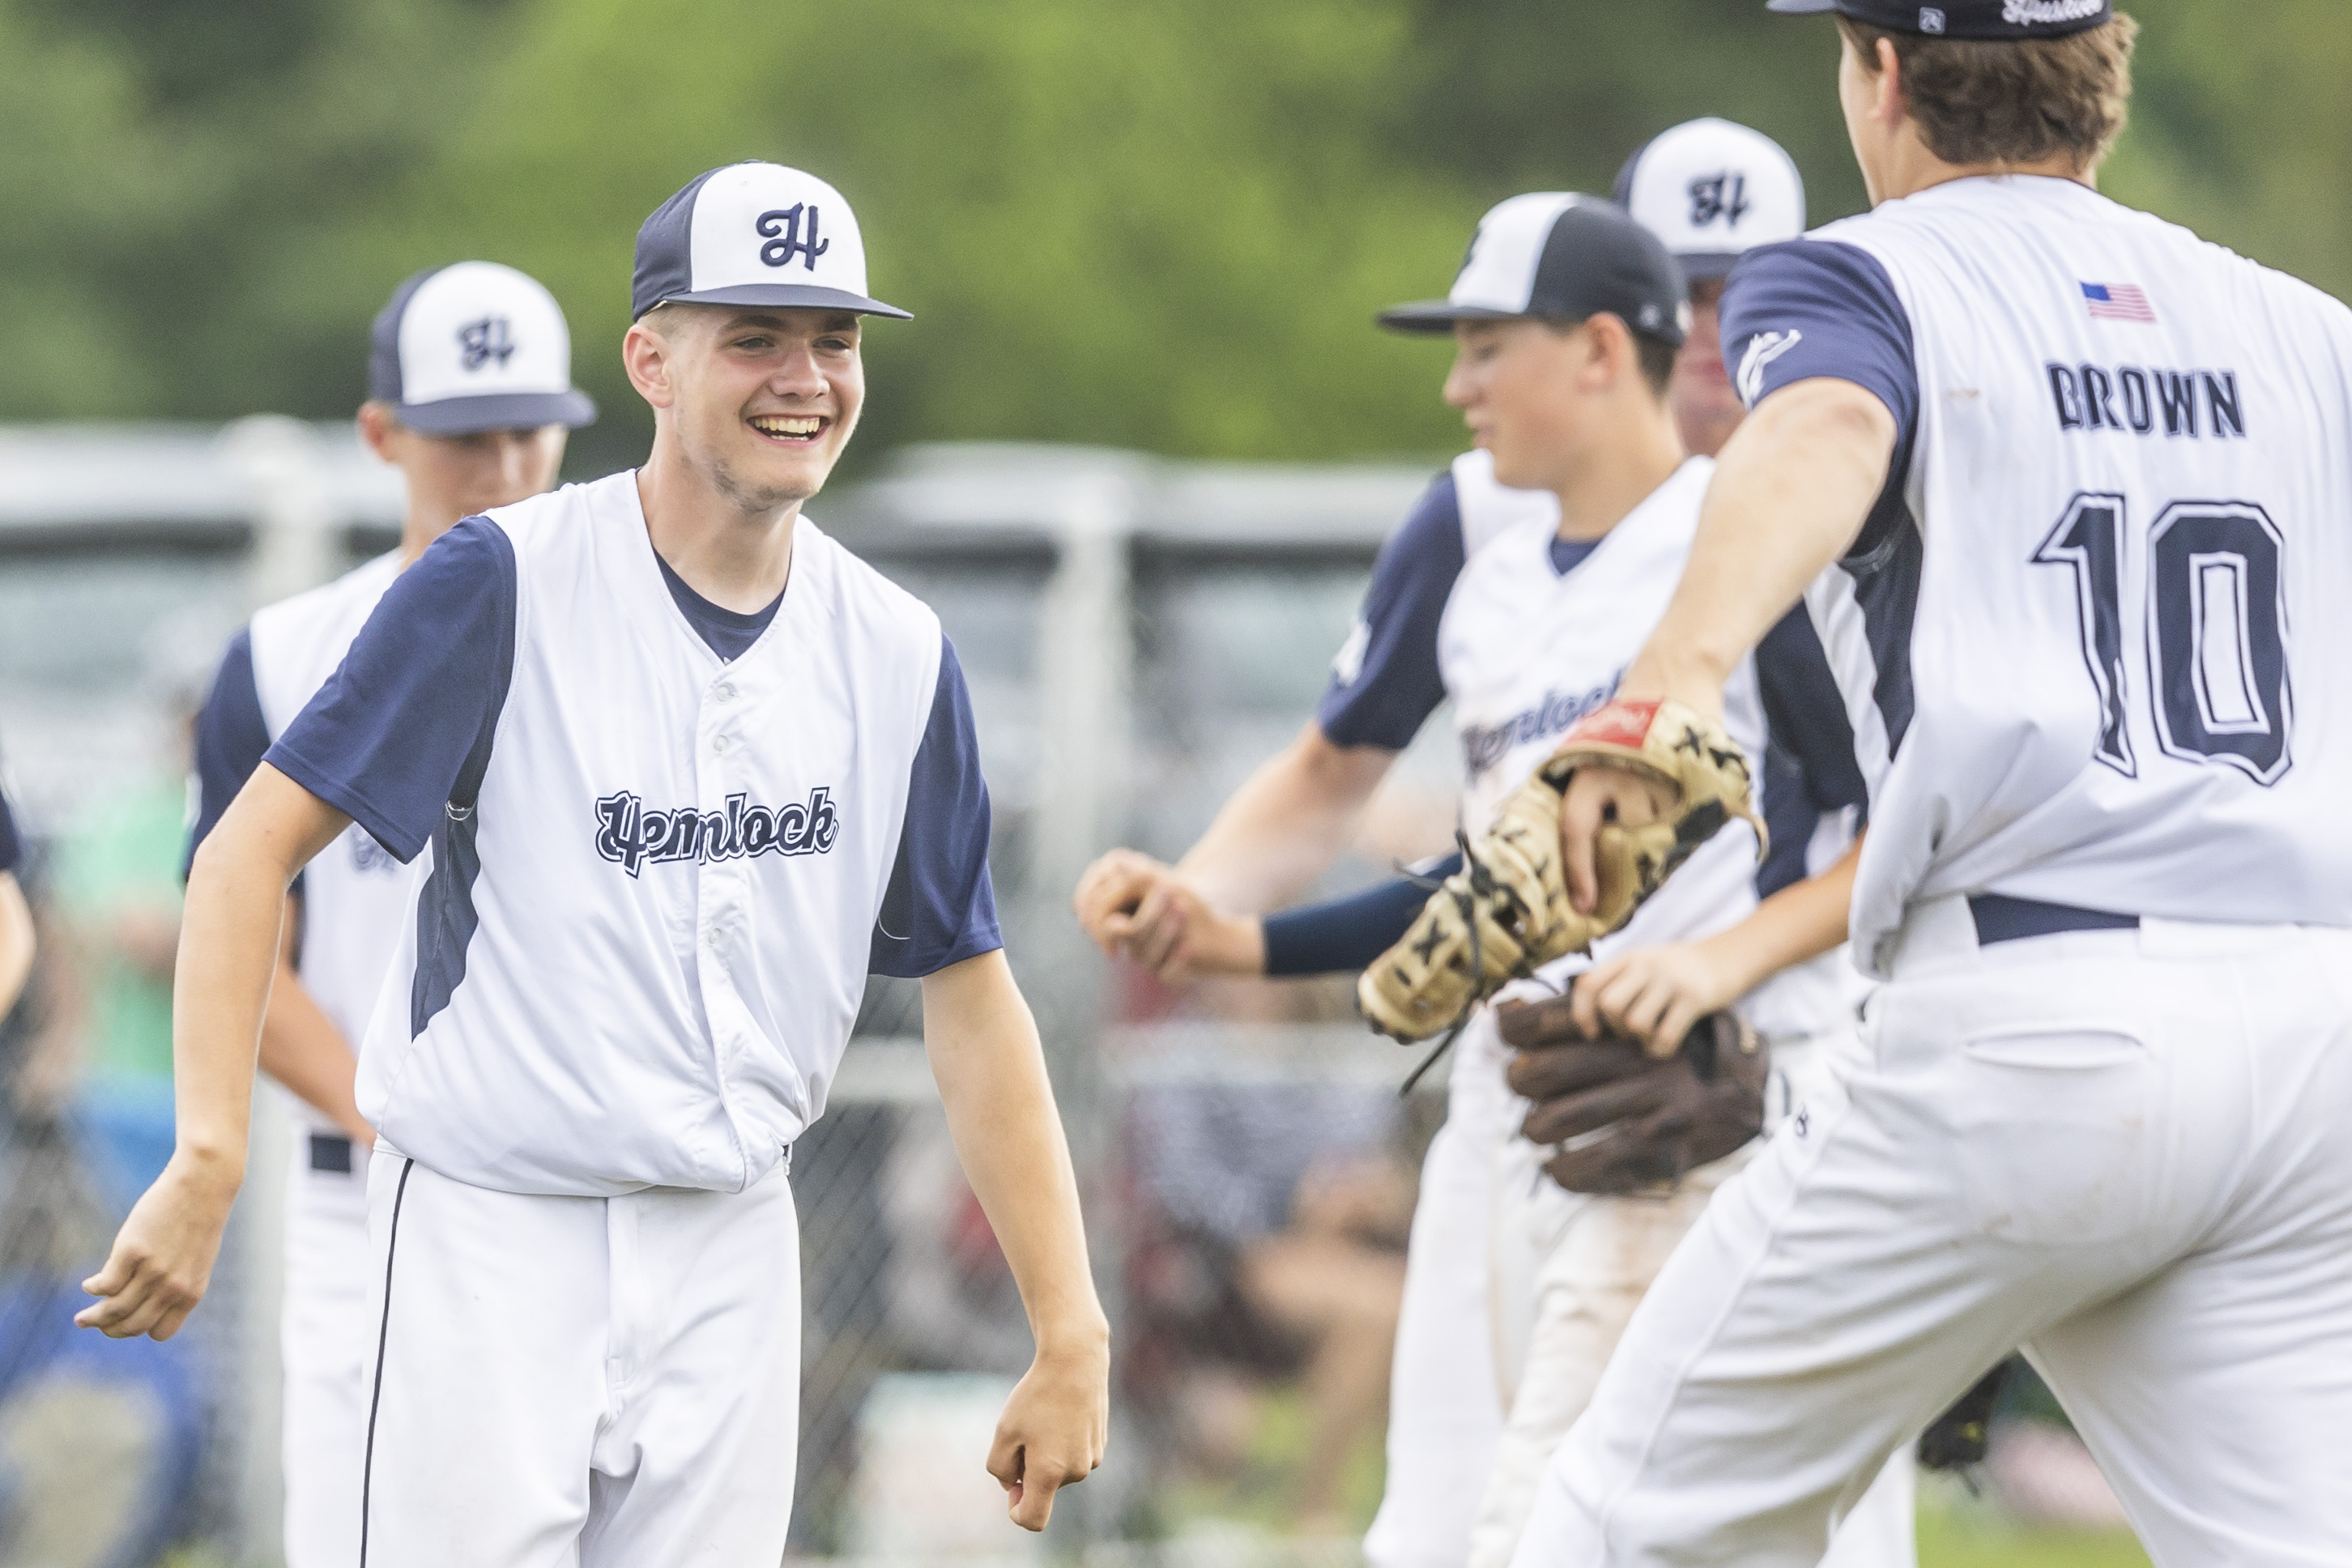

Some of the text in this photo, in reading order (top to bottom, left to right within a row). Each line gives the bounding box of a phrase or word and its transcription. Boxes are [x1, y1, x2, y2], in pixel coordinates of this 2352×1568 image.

[756, 202, 829, 271] H
[2047, 362, 2246, 438] BROWN
[2027, 491, 2293, 787] 10
[595, 786, 839, 880] Hemlock
